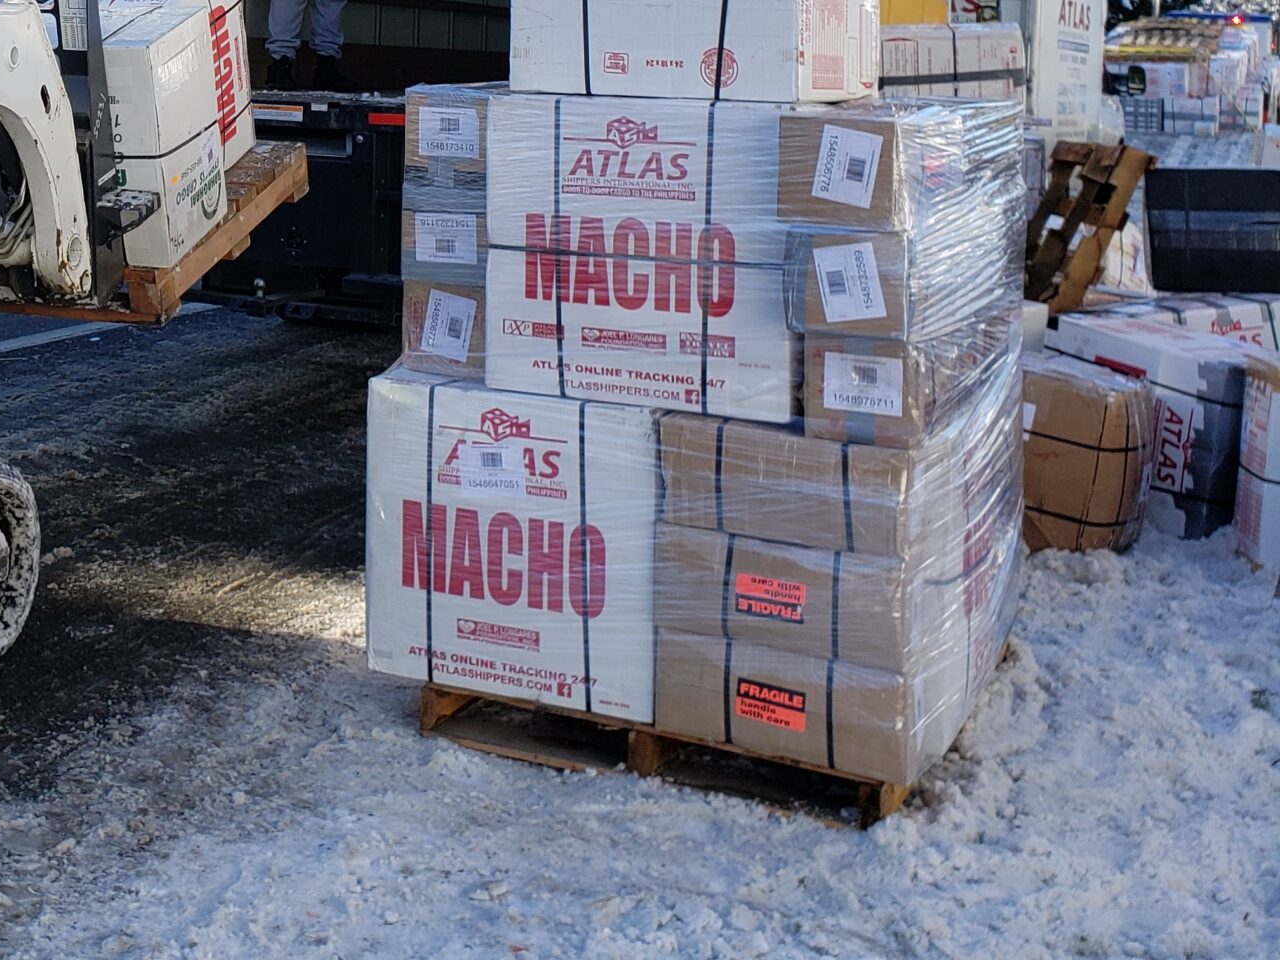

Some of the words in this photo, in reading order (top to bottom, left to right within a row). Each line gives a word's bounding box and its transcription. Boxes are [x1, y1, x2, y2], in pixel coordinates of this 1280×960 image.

[568, 149, 690, 180] ATLAS
[562, 177, 602, 185] SHIPPERS
[610, 189, 630, 197] CARGO
[654, 192, 694, 200] PHILIPPINES
[524, 212, 735, 317] MACHO
[601, 330, 617, 339] JOEL
[532, 360, 571, 372] ATLS
[575, 364, 622, 378] ONLINE
[626, 370, 695, 386] TRACKING
[699, 378, 726, 389] 4/7
[558, 380, 680, 401] TLASSHIPPERS.COM
[1156, 405, 1183, 488] ATLAS
[444, 439, 561, 479] AAS
[527, 486, 566, 499] PHILIPPINES
[400, 499, 606, 619] MACHO
[751, 577, 774, 587] care
[778, 583, 801, 591] with
[764, 589, 801, 601] handle
[738, 598, 802, 620] FRAGILE
[476, 623, 492, 633] JOEL
[433, 663, 552, 694] ATLASSHIPPERS.COM
[451, 653, 497, 669] ONLINE
[501, 662, 567, 682] TRACKING
[571, 674, 598, 687] 247
[740, 682, 803, 708] FRAGILE
[740, 699, 776, 715] handle
[740, 708, 763, 720] with
[766, 716, 791, 726] care
